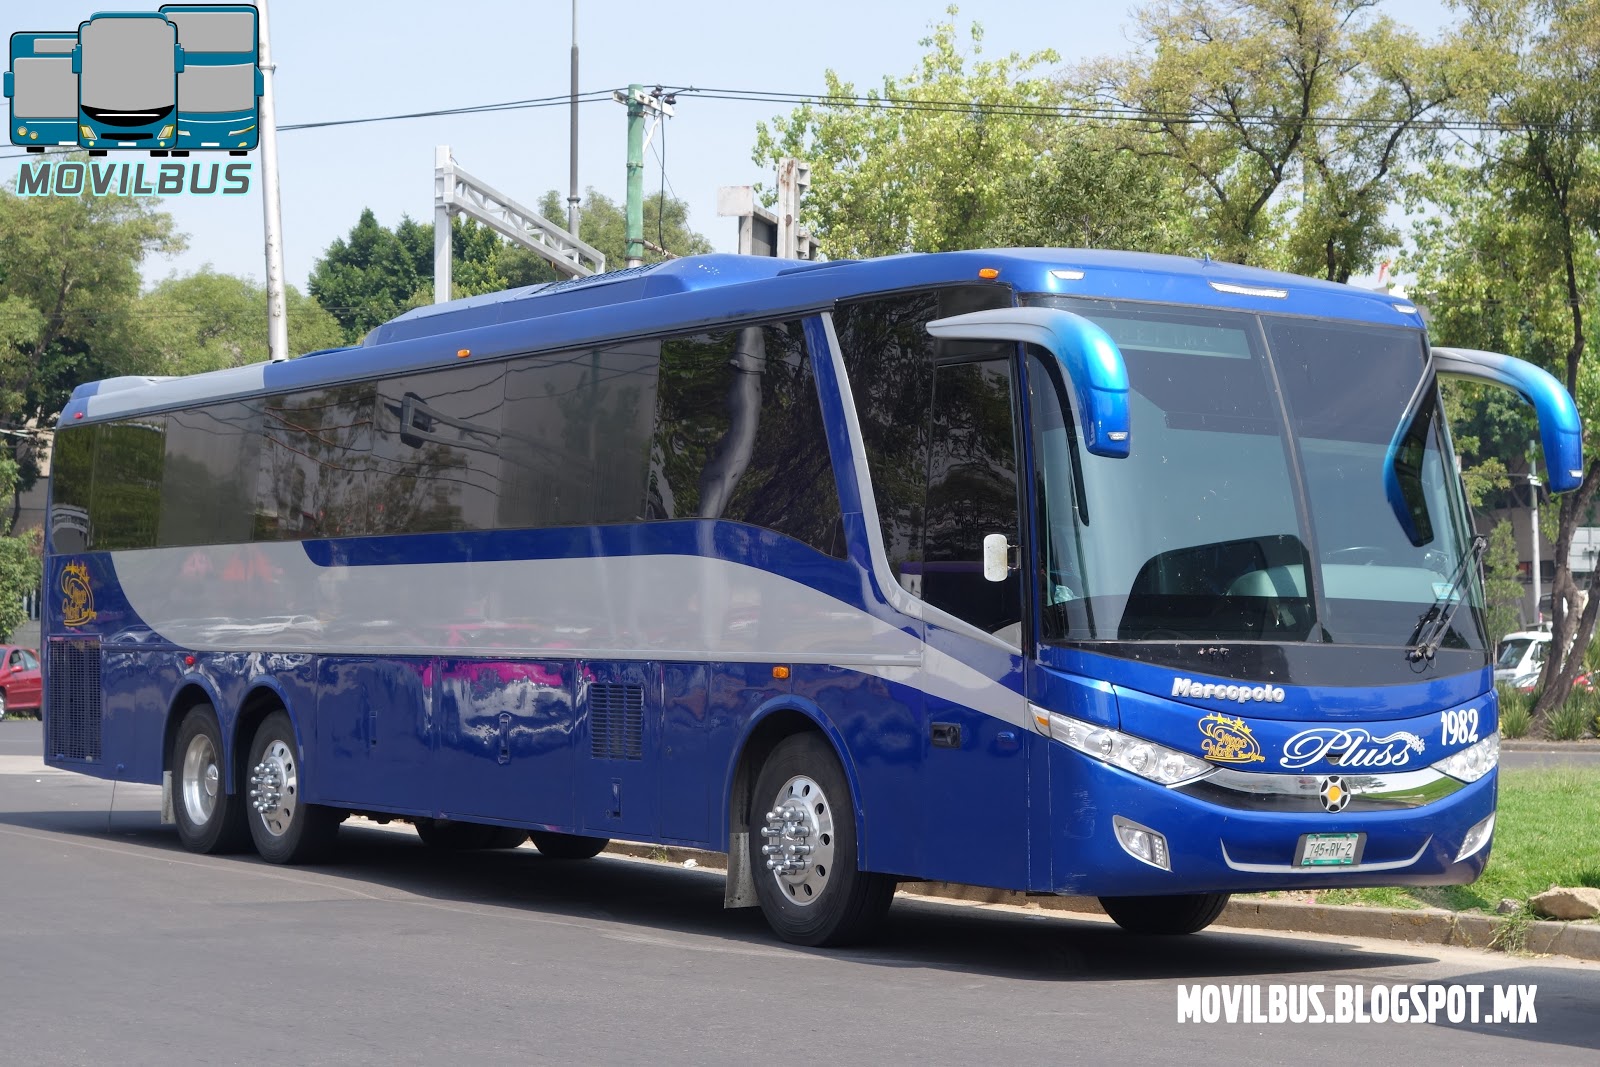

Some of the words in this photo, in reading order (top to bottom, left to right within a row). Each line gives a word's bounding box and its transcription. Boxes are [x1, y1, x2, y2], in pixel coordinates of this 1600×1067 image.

[1171, 677, 1286, 704] Marcopolo
[1440, 708, 1479, 746] 1982
[1279, 728, 1412, 768] Pluss
